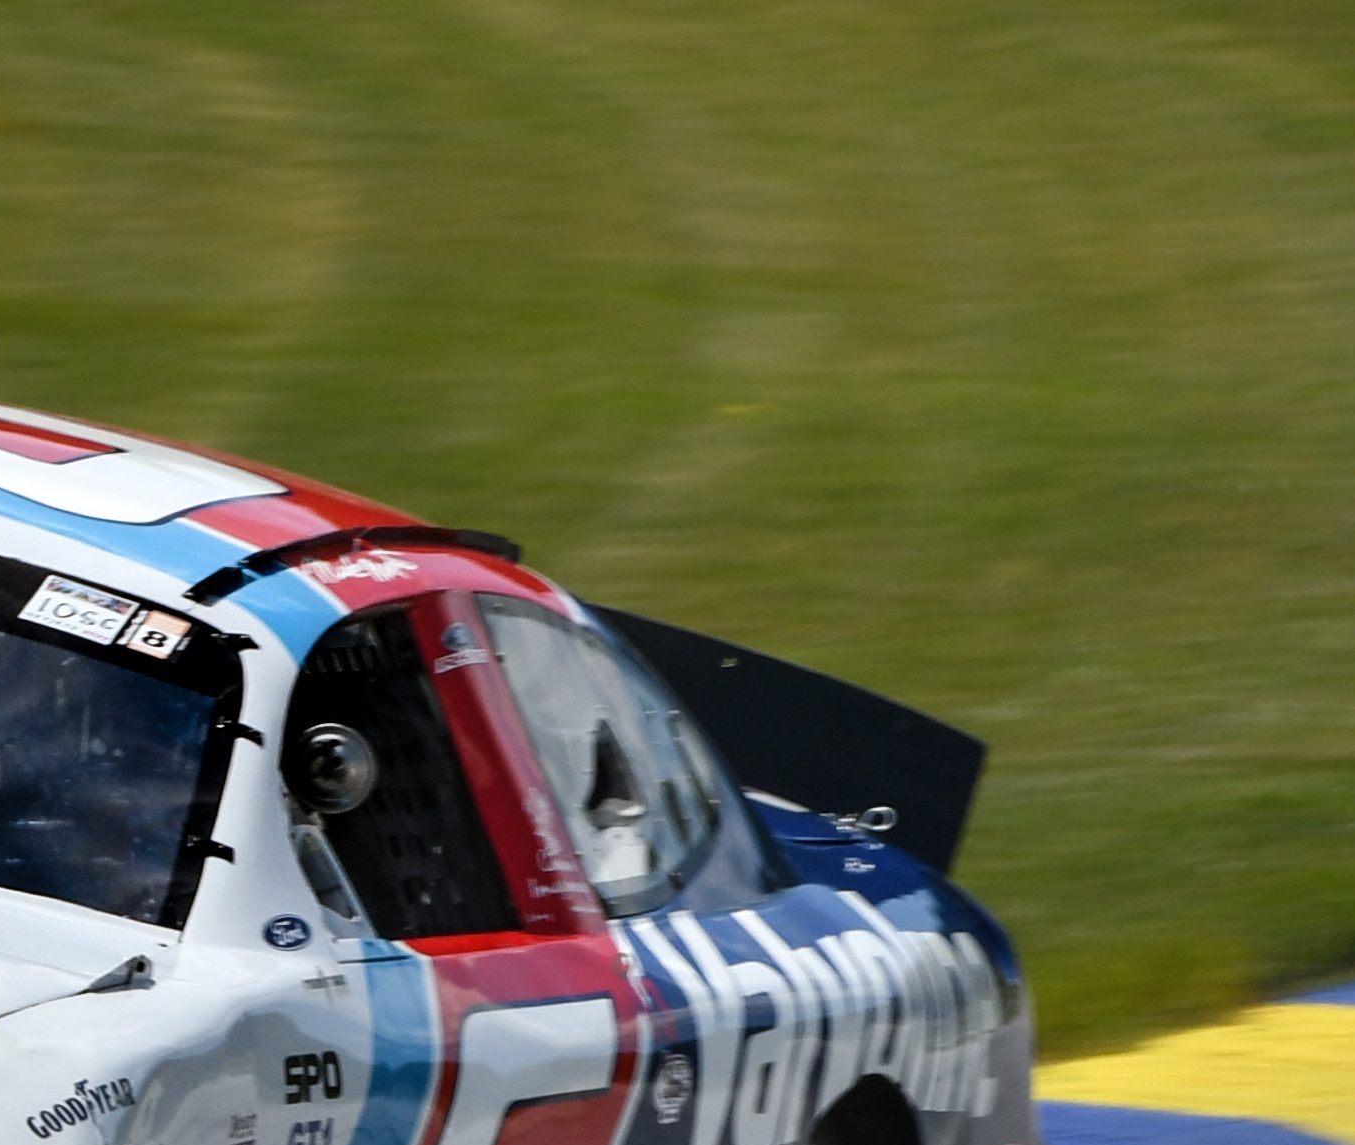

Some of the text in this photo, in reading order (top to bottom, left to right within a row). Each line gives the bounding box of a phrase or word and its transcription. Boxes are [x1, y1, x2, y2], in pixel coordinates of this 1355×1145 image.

[141, 630, 168, 648] 8
[284, 1050, 343, 1105] SPO
[26, 1077, 136, 1139] GOODYEAR
